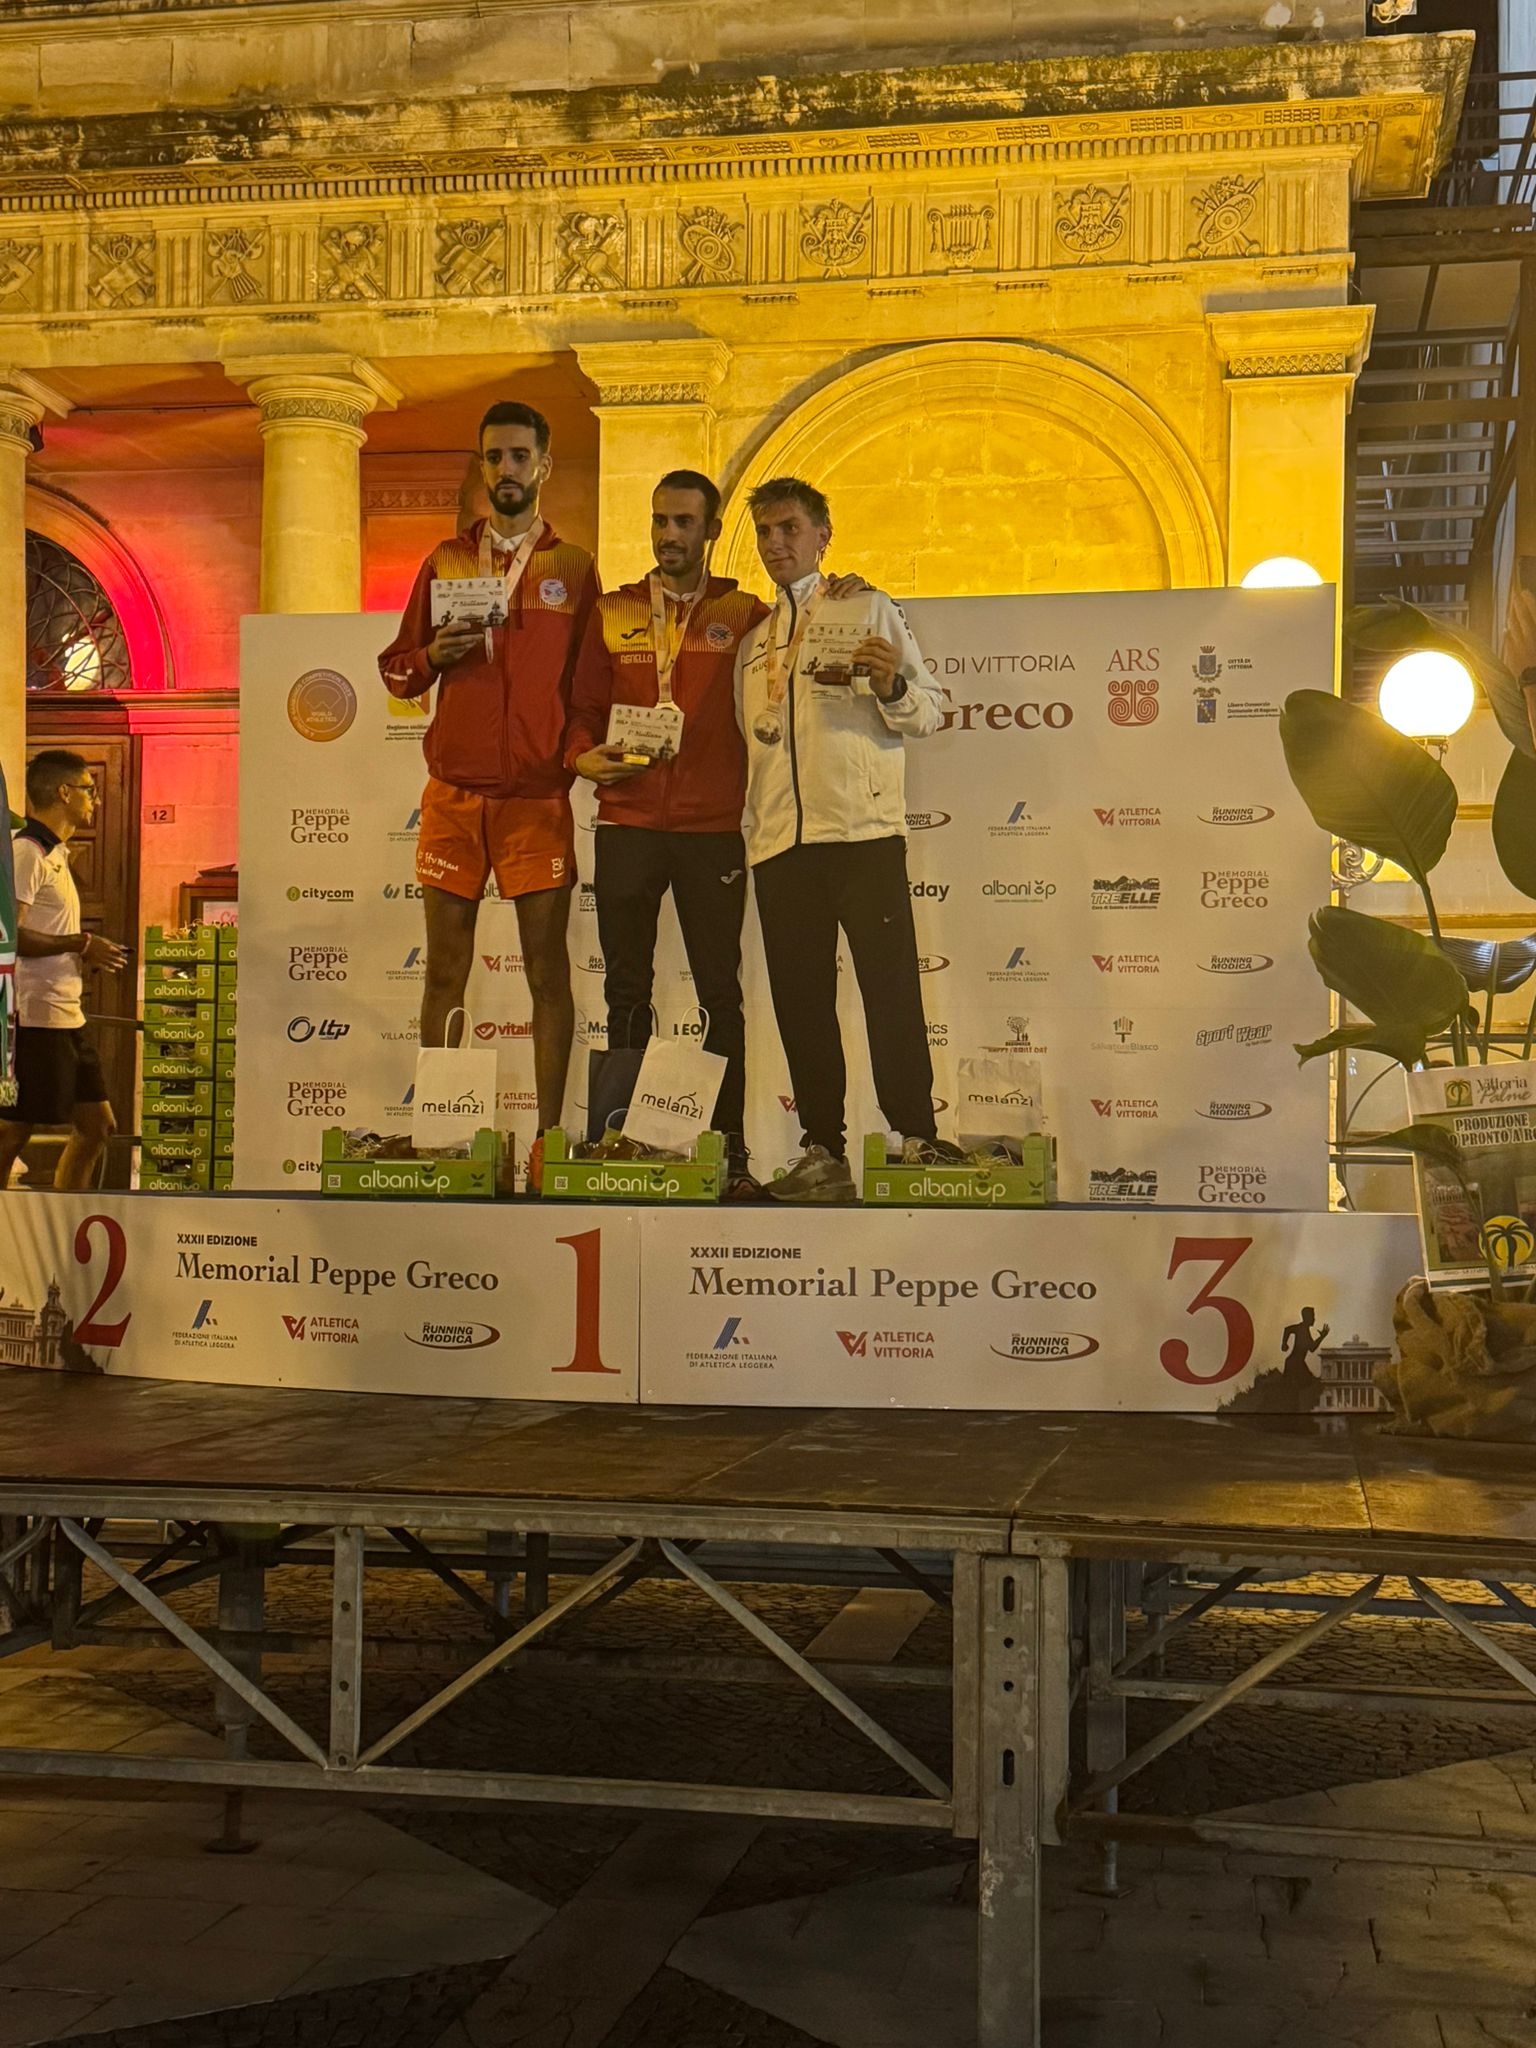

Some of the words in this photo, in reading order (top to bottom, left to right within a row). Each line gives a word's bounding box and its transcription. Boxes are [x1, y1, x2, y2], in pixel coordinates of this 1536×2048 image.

[946, 657, 965, 674] DI
[972, 654, 1076, 674] VITTORIA
[1106, 648, 1160, 672] ARS
[152, 810, 167, 821] 12
[291, 809, 350, 830] Peppe
[1118, 808, 1161, 816] ATLETICA
[1119, 818, 1161, 826] VITTORIA
[291, 826, 348, 843] Greco
[1201, 871, 1269, 894] Peppe
[302, 888, 354, 900] citycom
[1091, 892, 1161, 904] TREELLE
[1201, 890, 1268, 908] Greco
[289, 947, 348, 968] Peppe
[289, 964, 347, 981] Greco
[318, 1019, 350, 1040] ltp
[1196, 1024, 1234, 1046] Sport
[1236, 1025, 1272, 1043] Wear
[288, 1082, 347, 1104] Peppe
[287, 1100, 345, 1116] Greco
[1455, 1114, 1528, 1132] PRODUZIONE
[1462, 1131, 1510, 1146] PRONTO
[1512, 1130, 1523, 1142] A
[1199, 1166, 1267, 1190] Peppe
[1089, 1185, 1158, 1196] TREELLE
[1198, 1185, 1266, 1204] Greco
[177, 1233, 204, 1245] XXXII
[207, 1235, 257, 1247] EDIZIONE
[690, 1247, 728, 1258] XXXII
[732, 1248, 801, 1259] EDIZIONE
[72, 1214, 132, 1347] 2
[175, 1251, 300, 1284] Memorial
[310, 1257, 396, 1295] Peppe
[407, 1260, 499, 1291] Greco
[688, 1266, 858, 1297] Memorial
[871, 1268, 978, 1307] Peppe
[992, 1269, 1097, 1300] Greco
[552, 1228, 621, 1374] 1
[1160, 1236, 1254, 1385] 3
[310, 1317, 359, 1328] ATLETICA
[422, 1325, 473, 1335] RUNNING
[172, 1332, 209, 1340] FEDERAZIONE
[310, 1332, 359, 1344] VITTORIA
[422, 1334, 472, 1343] MODICA
[873, 1332, 935, 1342] ATLETICA
[1012, 1337, 1070, 1346] RUNNING
[874, 1347, 934, 1358] VITTORIA
[1011, 1346, 1069, 1355] MODICA
